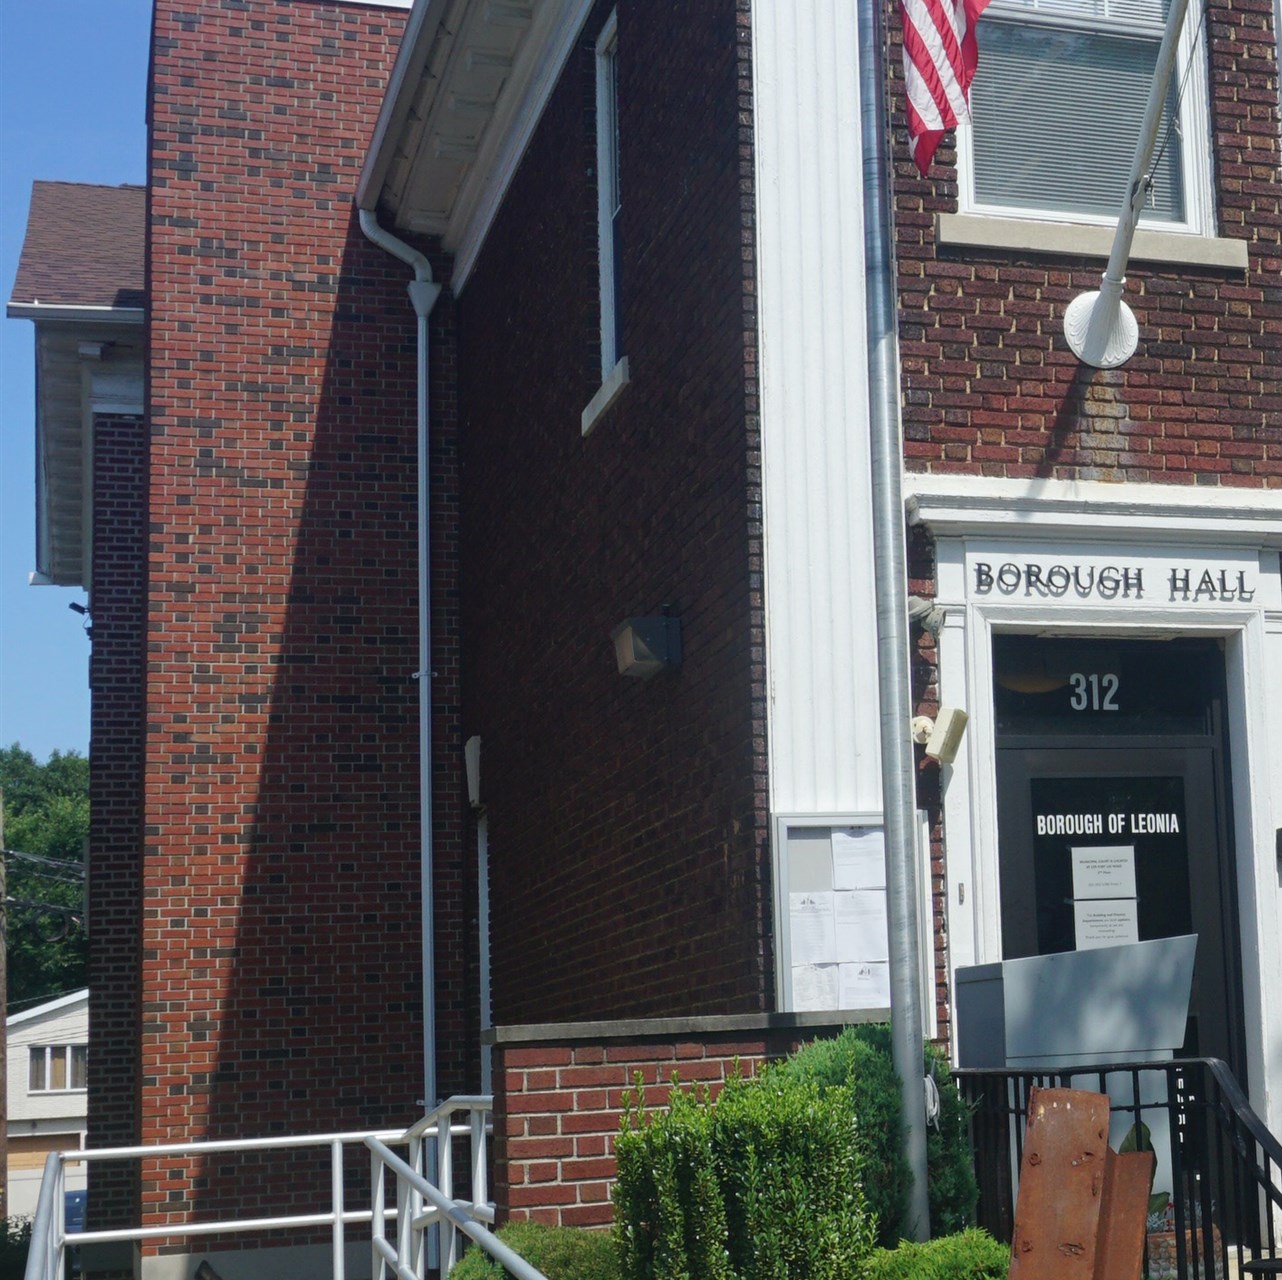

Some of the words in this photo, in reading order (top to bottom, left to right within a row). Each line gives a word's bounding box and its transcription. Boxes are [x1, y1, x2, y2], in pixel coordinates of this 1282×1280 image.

[975, 561, 1145, 598] BOROUGH
[1169, 567, 1256, 599] HALL
[1068, 672, 1120, 712] 312
[1036, 814, 1103, 836] BOROUGH
[1108, 813, 1126, 834] OF
[1130, 813, 1180, 834] LEONIA
